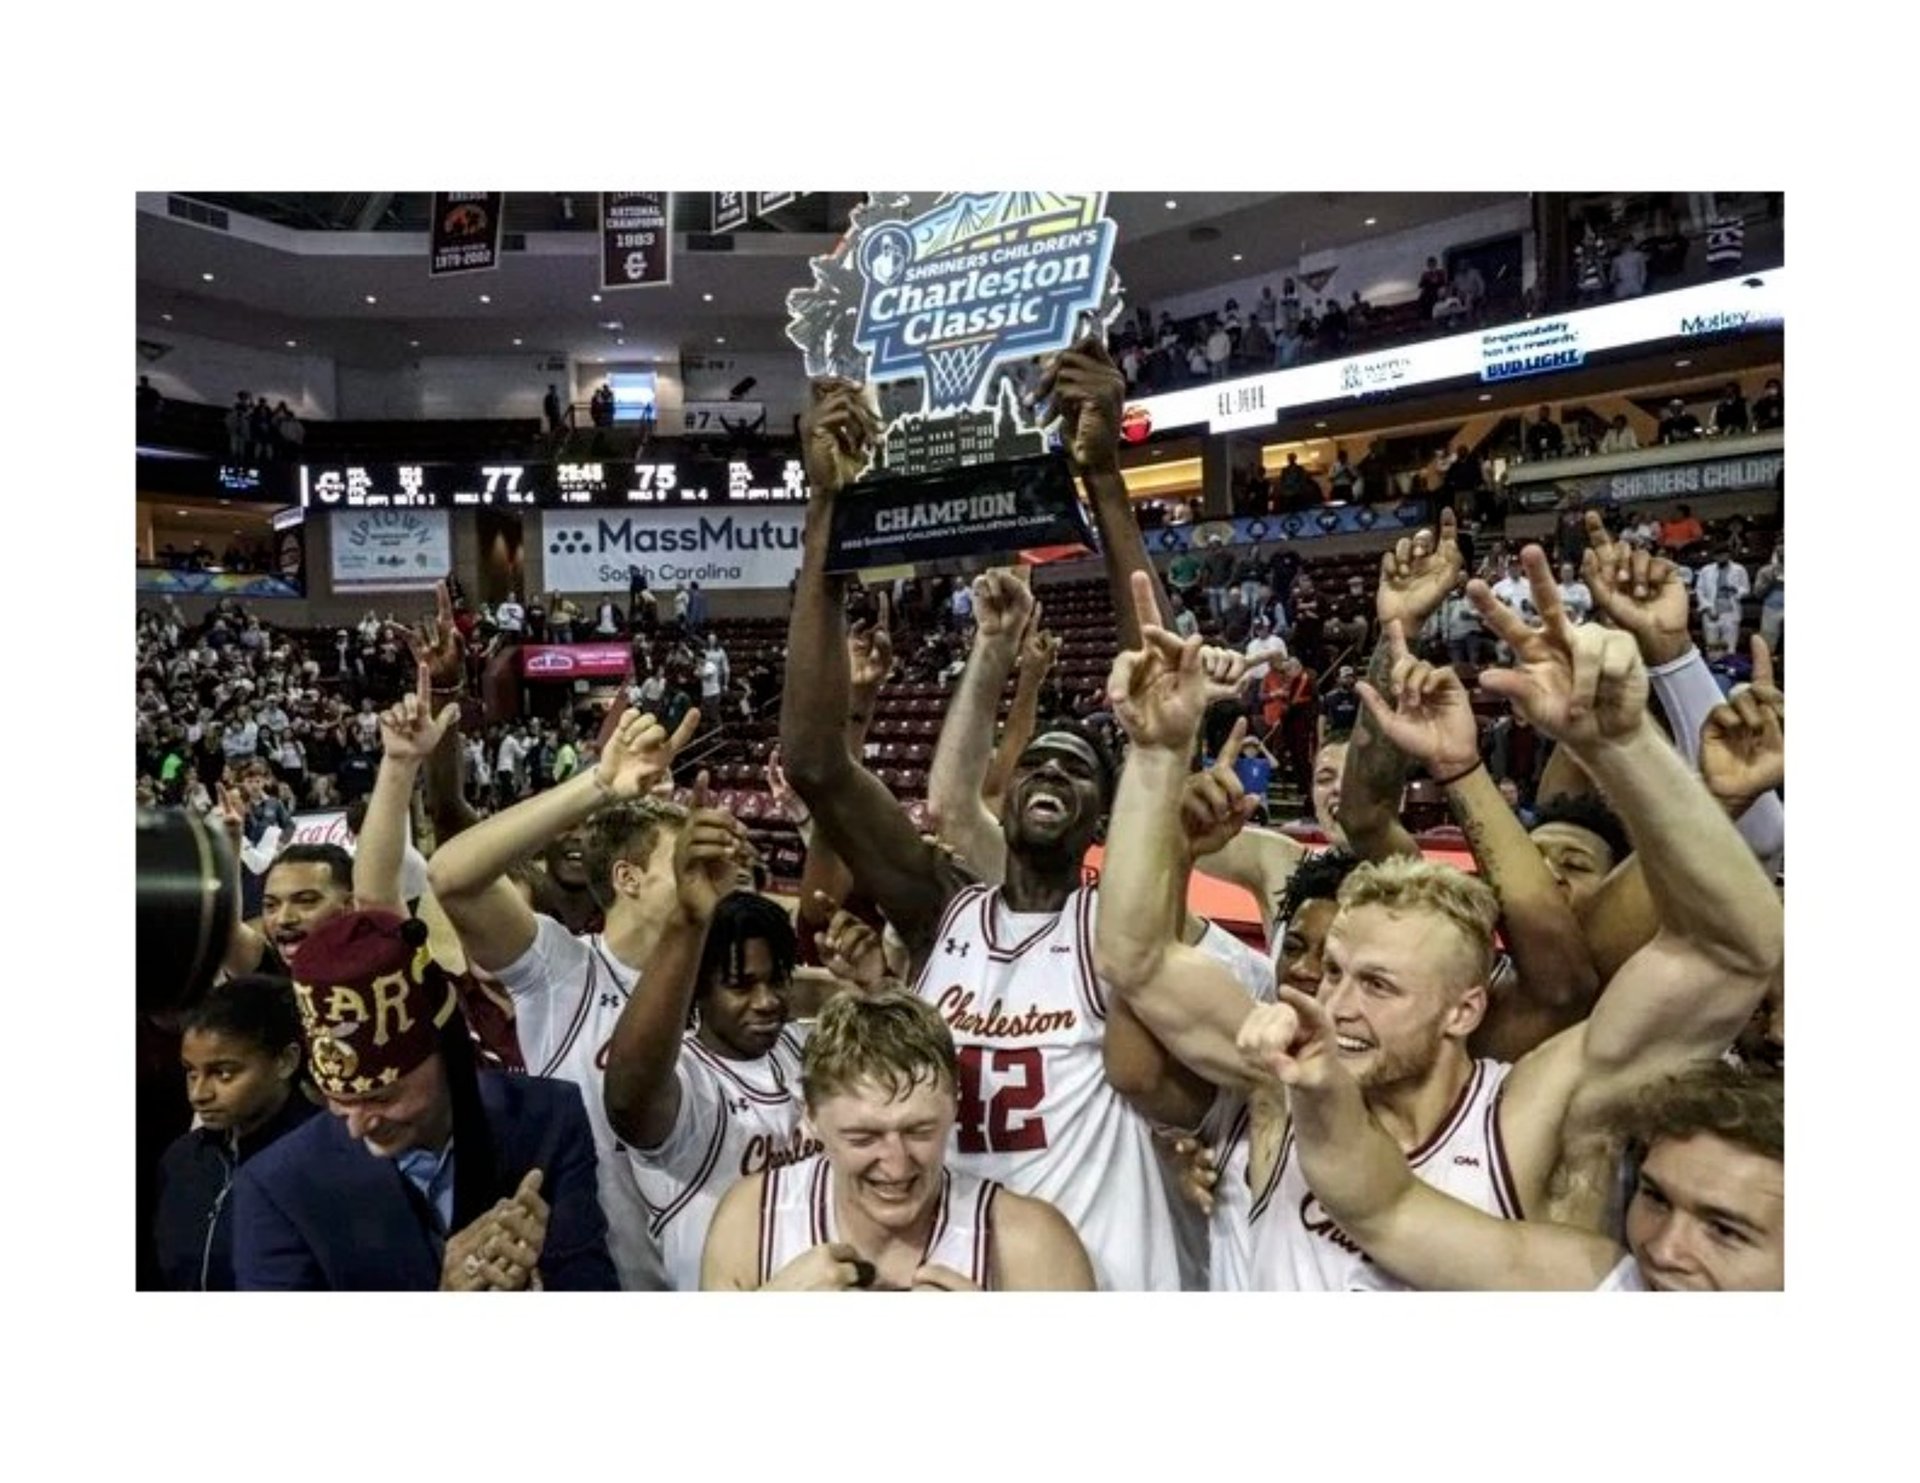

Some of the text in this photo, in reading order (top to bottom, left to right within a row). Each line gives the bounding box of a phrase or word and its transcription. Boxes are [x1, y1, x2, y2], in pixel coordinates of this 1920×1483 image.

[904, 230, 1097, 282] SHRINERS CHILDREN'S
[870, 253, 1092, 321] Charleston
[903, 293, 1043, 345] Classic
[1681, 309, 1750, 333] Motley
[1487, 348, 1578, 379] BUD LIGHT
[482, 466, 524, 492] 77
[635, 464, 676, 490] 75
[1611, 467, 1699, 500] SHRINERS
[349, 509, 432, 546] UPTOWN
[875, 492, 1016, 532] CHAMPION
[598, 516, 806, 553] MassMutu
[600, 563, 741, 582] Souh Carolina
[937, 984, 1076, 1039] Charleston
